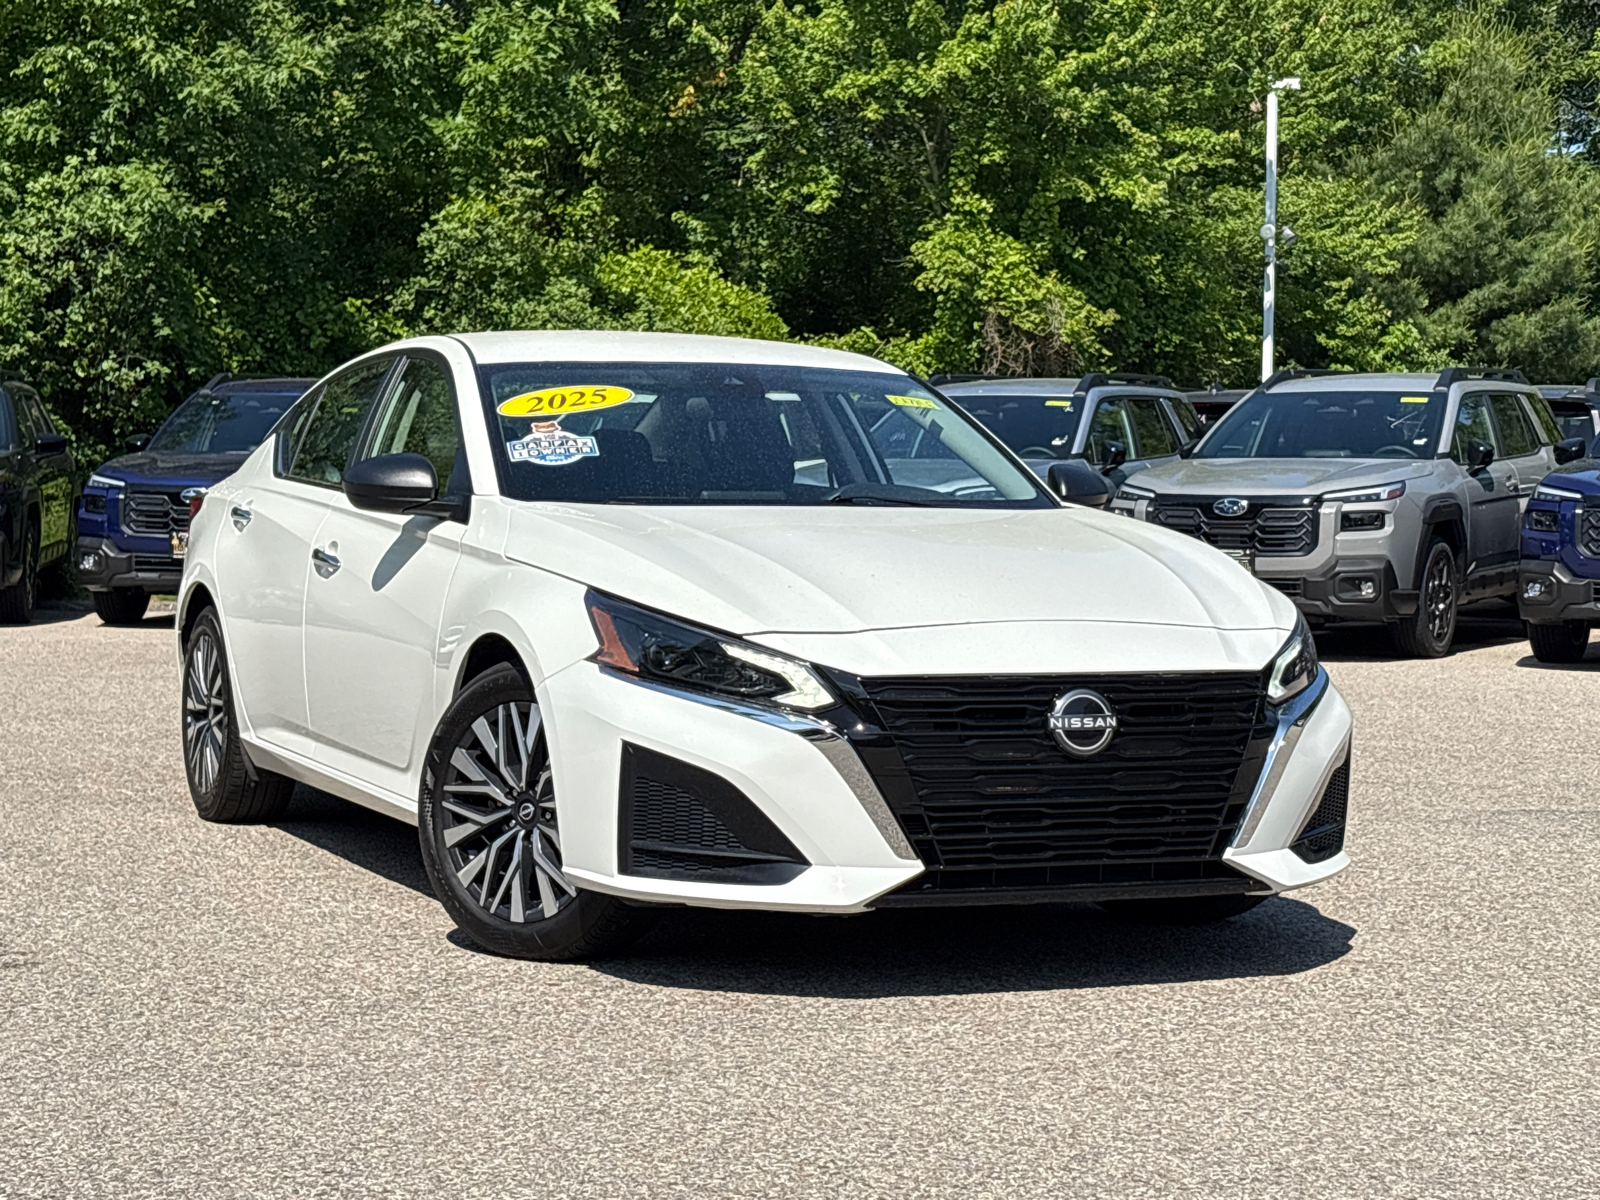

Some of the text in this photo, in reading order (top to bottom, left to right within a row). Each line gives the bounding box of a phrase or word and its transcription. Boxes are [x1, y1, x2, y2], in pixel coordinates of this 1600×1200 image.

[526, 388, 607, 414] 2025
[514, 439, 589, 450] CARFAX
[529, 447, 591, 456] OWNER
[1050, 716, 1116, 728] NISSAN
